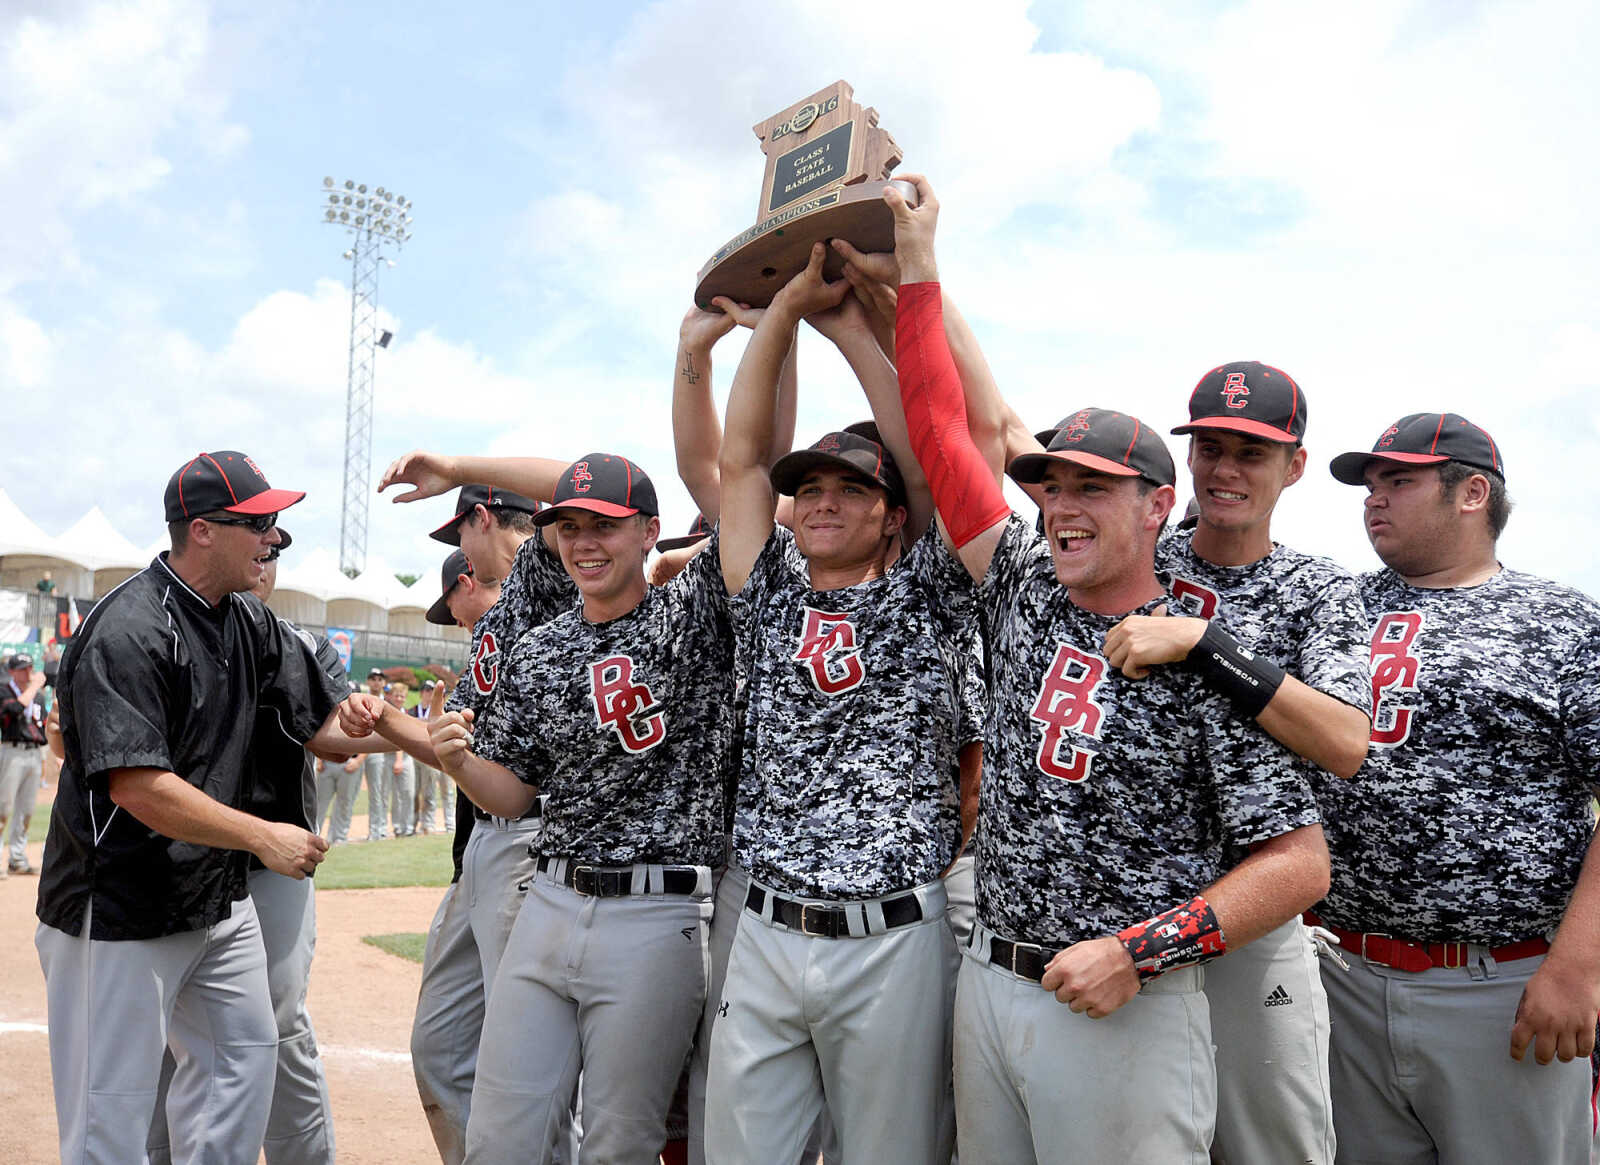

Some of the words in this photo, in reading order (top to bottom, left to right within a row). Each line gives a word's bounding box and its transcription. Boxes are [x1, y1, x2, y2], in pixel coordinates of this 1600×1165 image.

[793, 146, 824, 168] CLASS
[795, 156, 825, 177] STATE
[784, 163, 834, 193] BASEBALL
[756, 199, 821, 234] CHAMPIONS
[1220, 372, 1251, 409] BC
[570, 461, 593, 493] BC
[589, 655, 668, 755] BC
[1031, 641, 1110, 783] BC
[1264, 997, 1293, 1008] adidas
